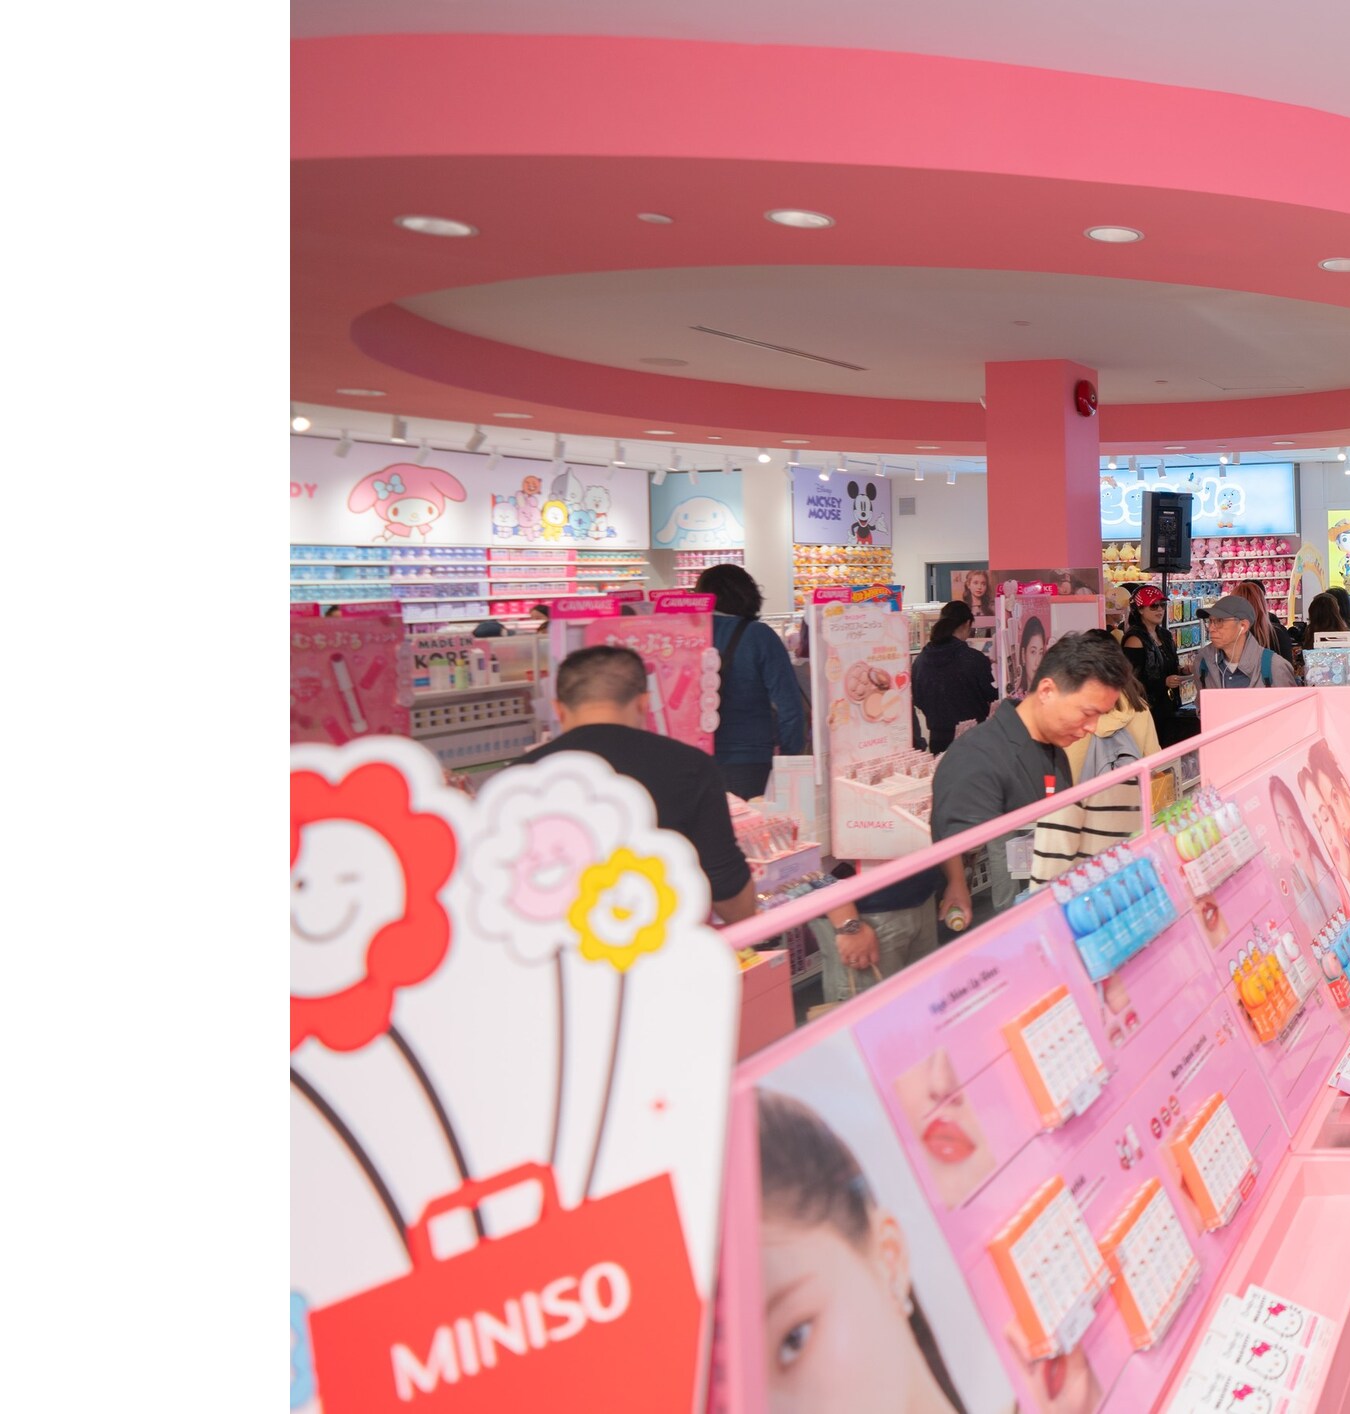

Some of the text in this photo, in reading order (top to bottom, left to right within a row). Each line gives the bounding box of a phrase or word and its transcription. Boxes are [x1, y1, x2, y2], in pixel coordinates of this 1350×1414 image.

[806, 495, 842, 508] MICKEY
[808, 508, 842, 520] MOUSE
[661, 596, 710, 608] CANMAKE
[418, 636, 473, 649] MADE IN
[846, 820, 894, 830] CANMAKE
[390, 1261, 632, 1402] MINISO
